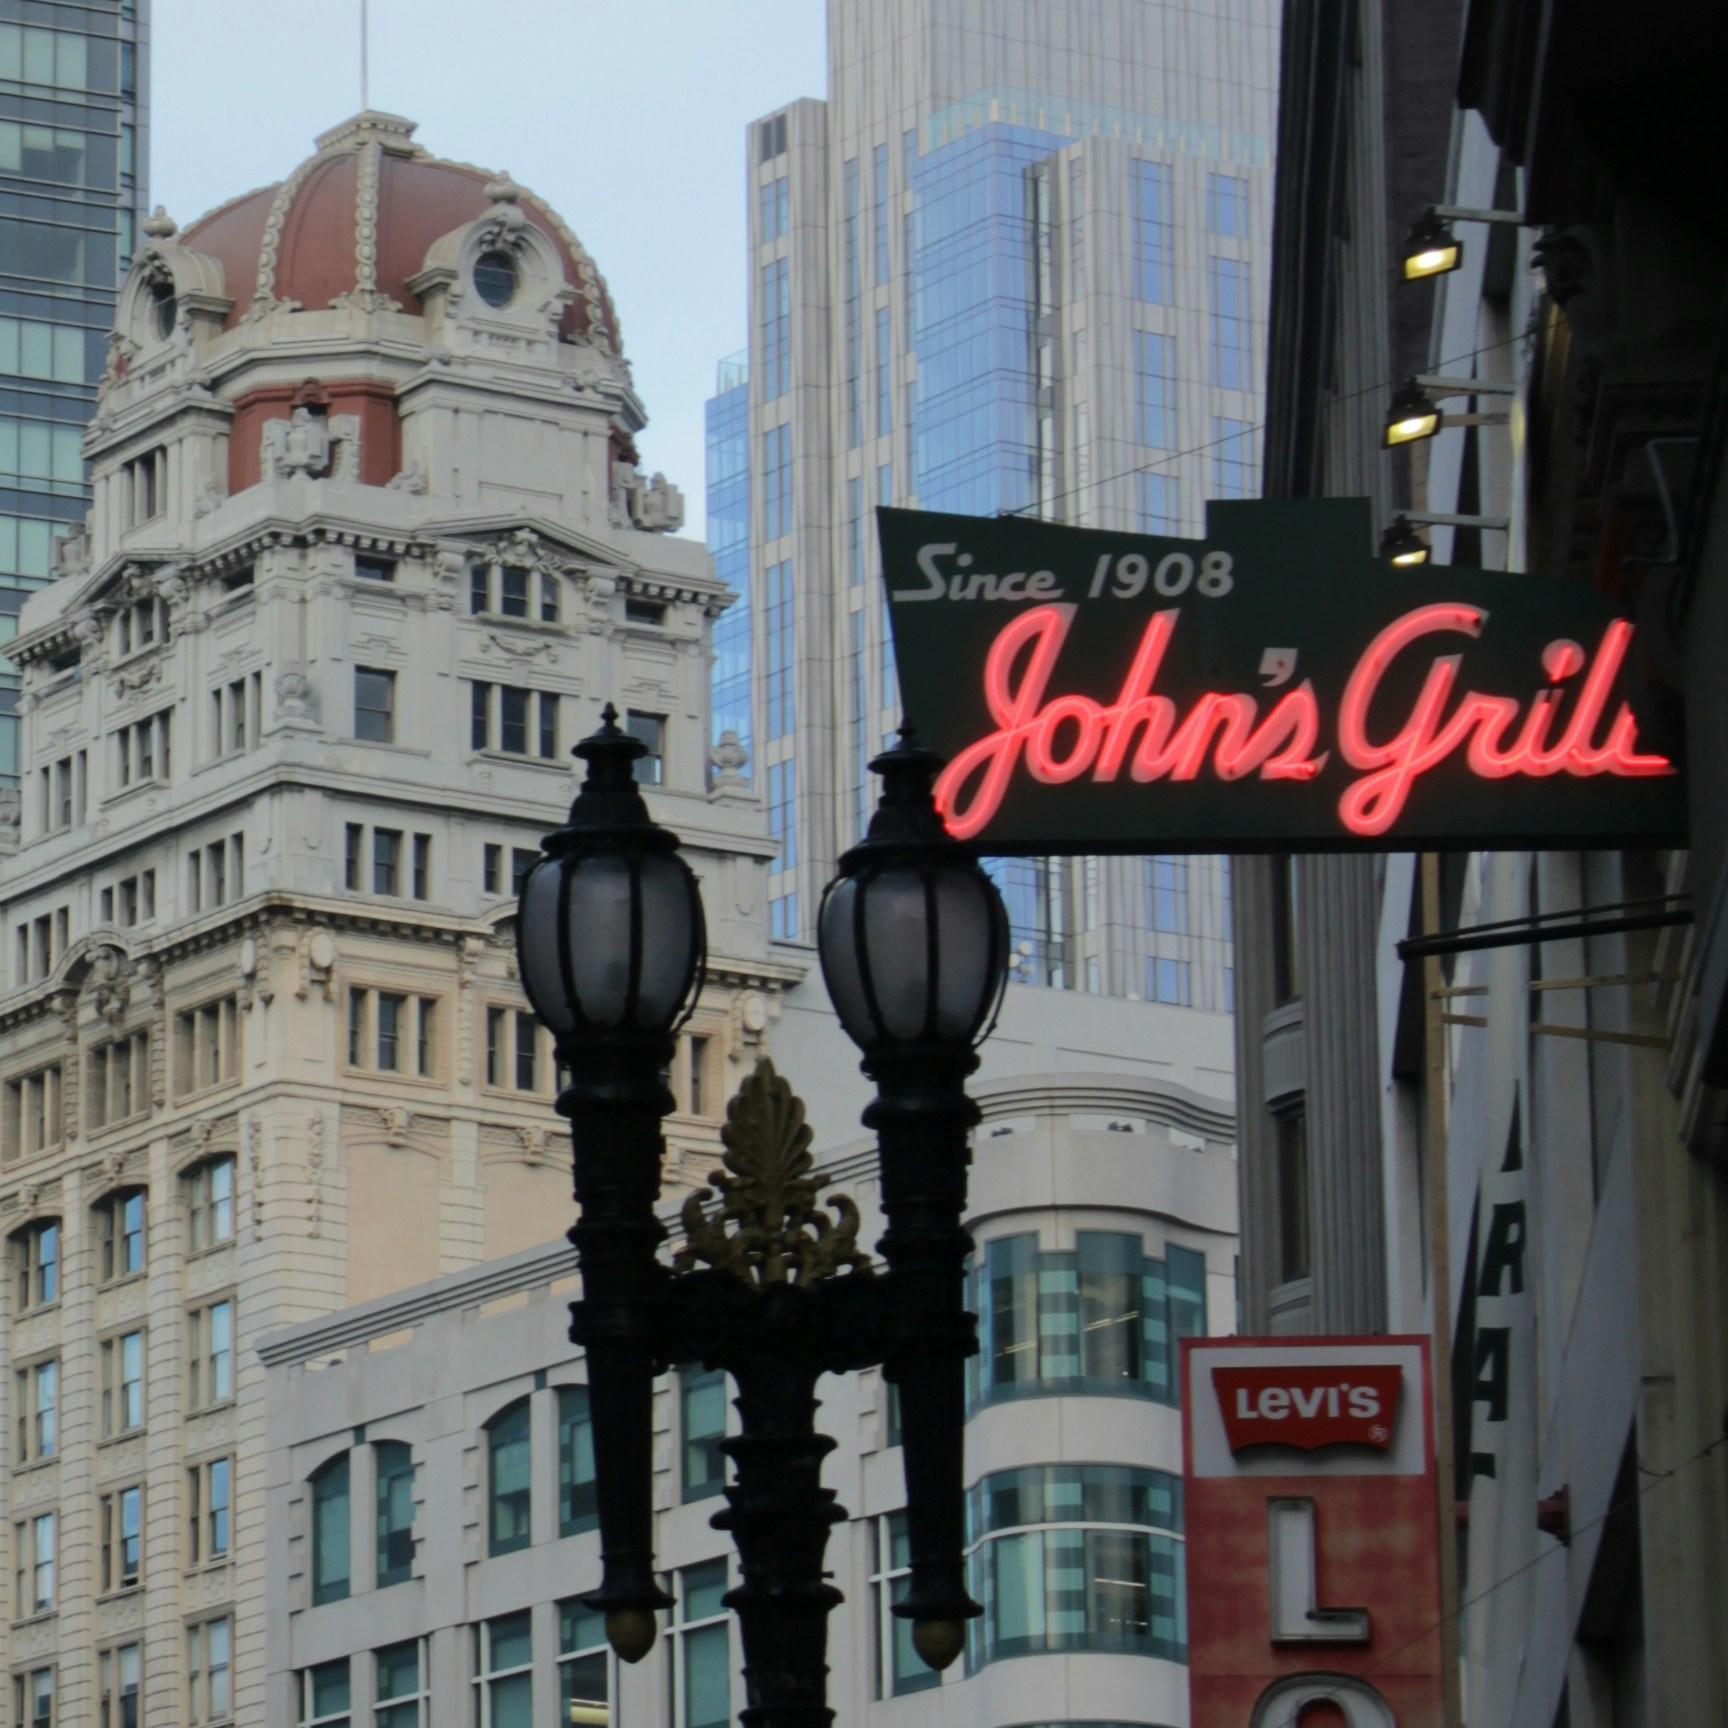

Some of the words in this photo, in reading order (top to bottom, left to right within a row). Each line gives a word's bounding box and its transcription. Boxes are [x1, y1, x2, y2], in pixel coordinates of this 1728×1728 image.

[893, 543, 1063, 602] Since
[1088, 551, 1234, 600] 1908
[930, 602, 1329, 841] John's
